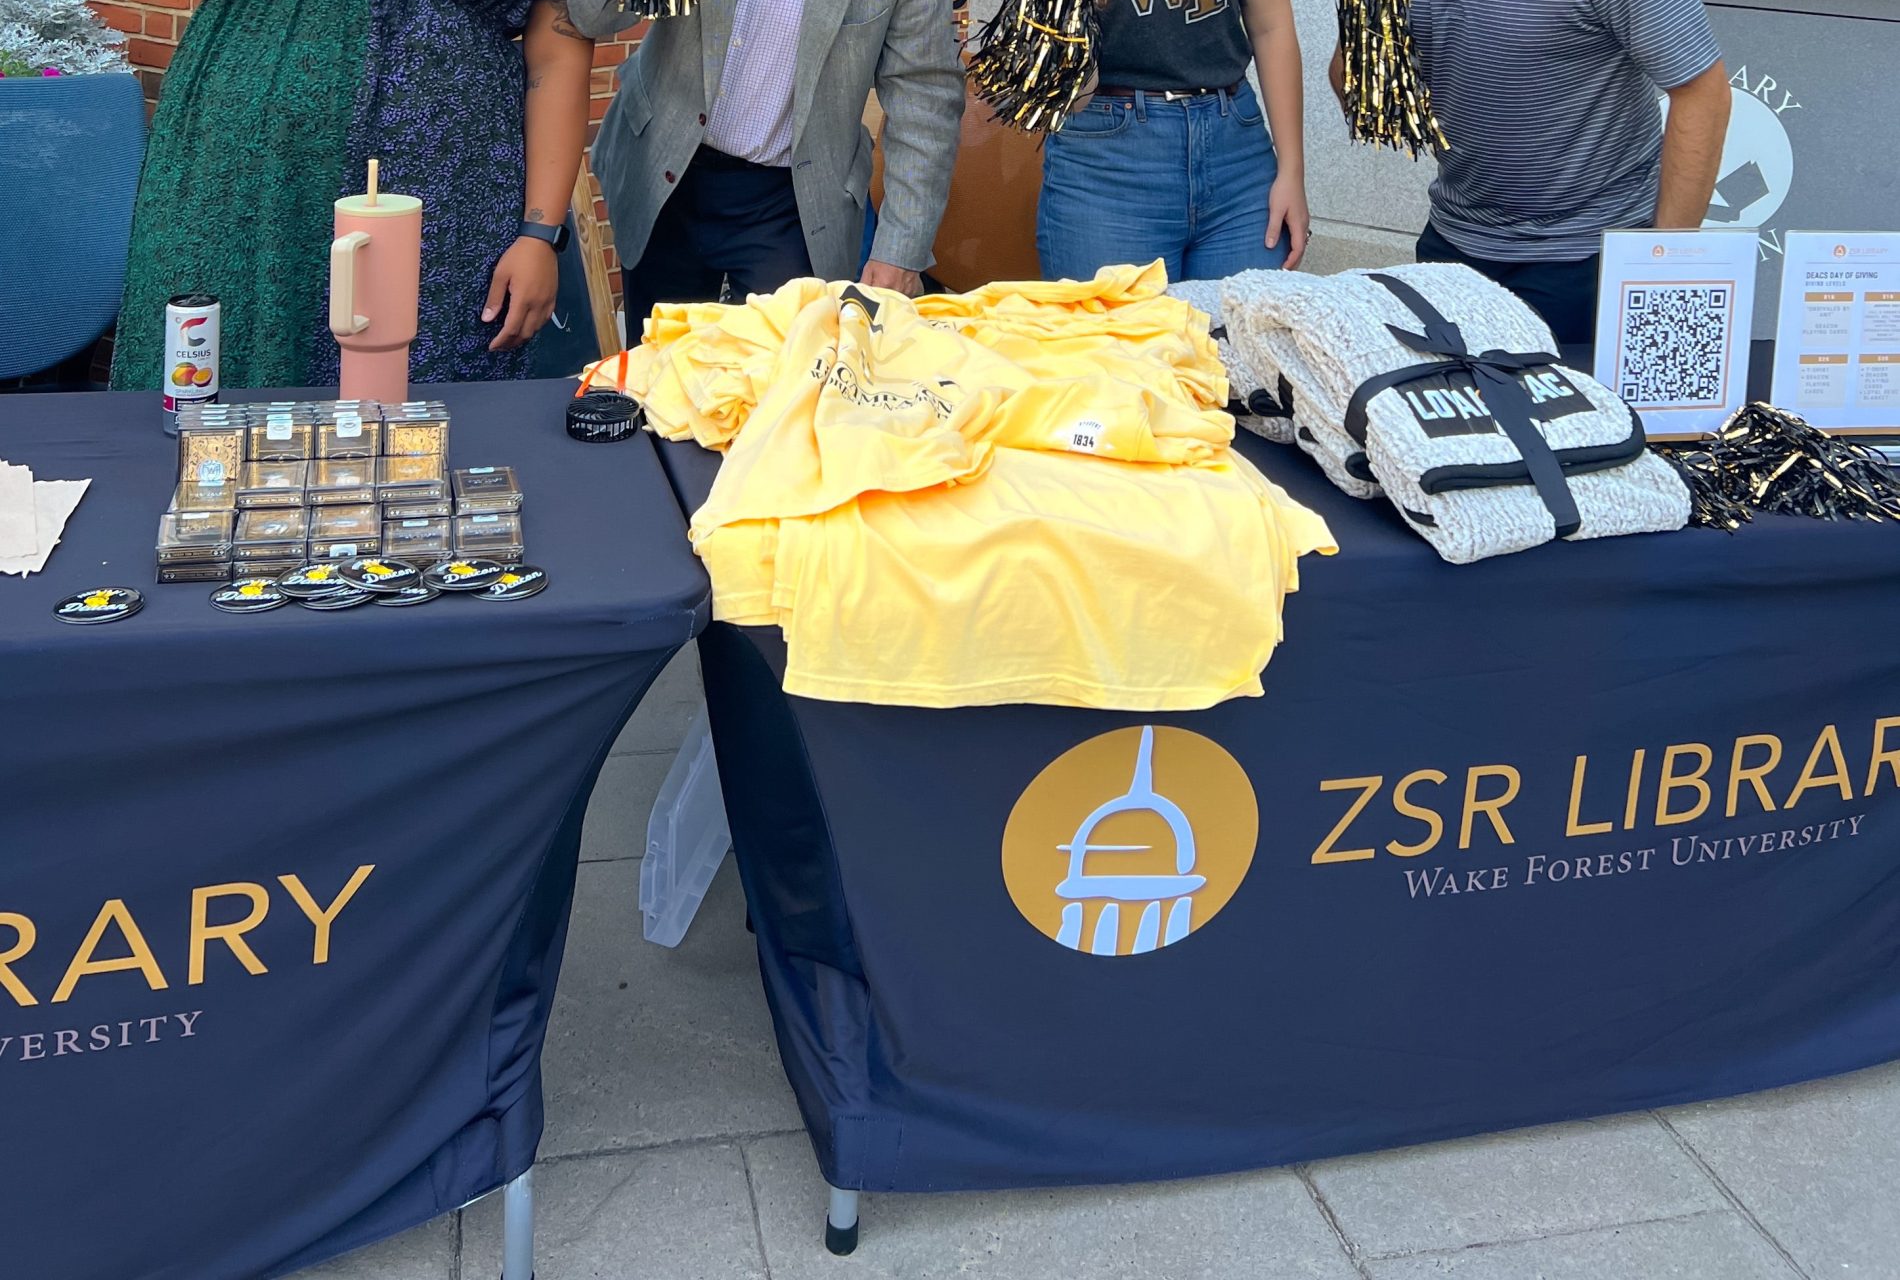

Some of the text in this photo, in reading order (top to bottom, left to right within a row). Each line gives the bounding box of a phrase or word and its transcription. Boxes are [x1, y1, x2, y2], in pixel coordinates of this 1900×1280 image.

[1855, 271, 1878, 279] GIVING
[176, 349, 211, 359] CELSIUS
[1073, 434, 1094, 448] 1834
[362, 568, 415, 584] Deacon
[443, 567, 500, 584] Deacon
[490, 571, 542, 595] Deacon
[1311, 764, 1522, 865] ZSR
